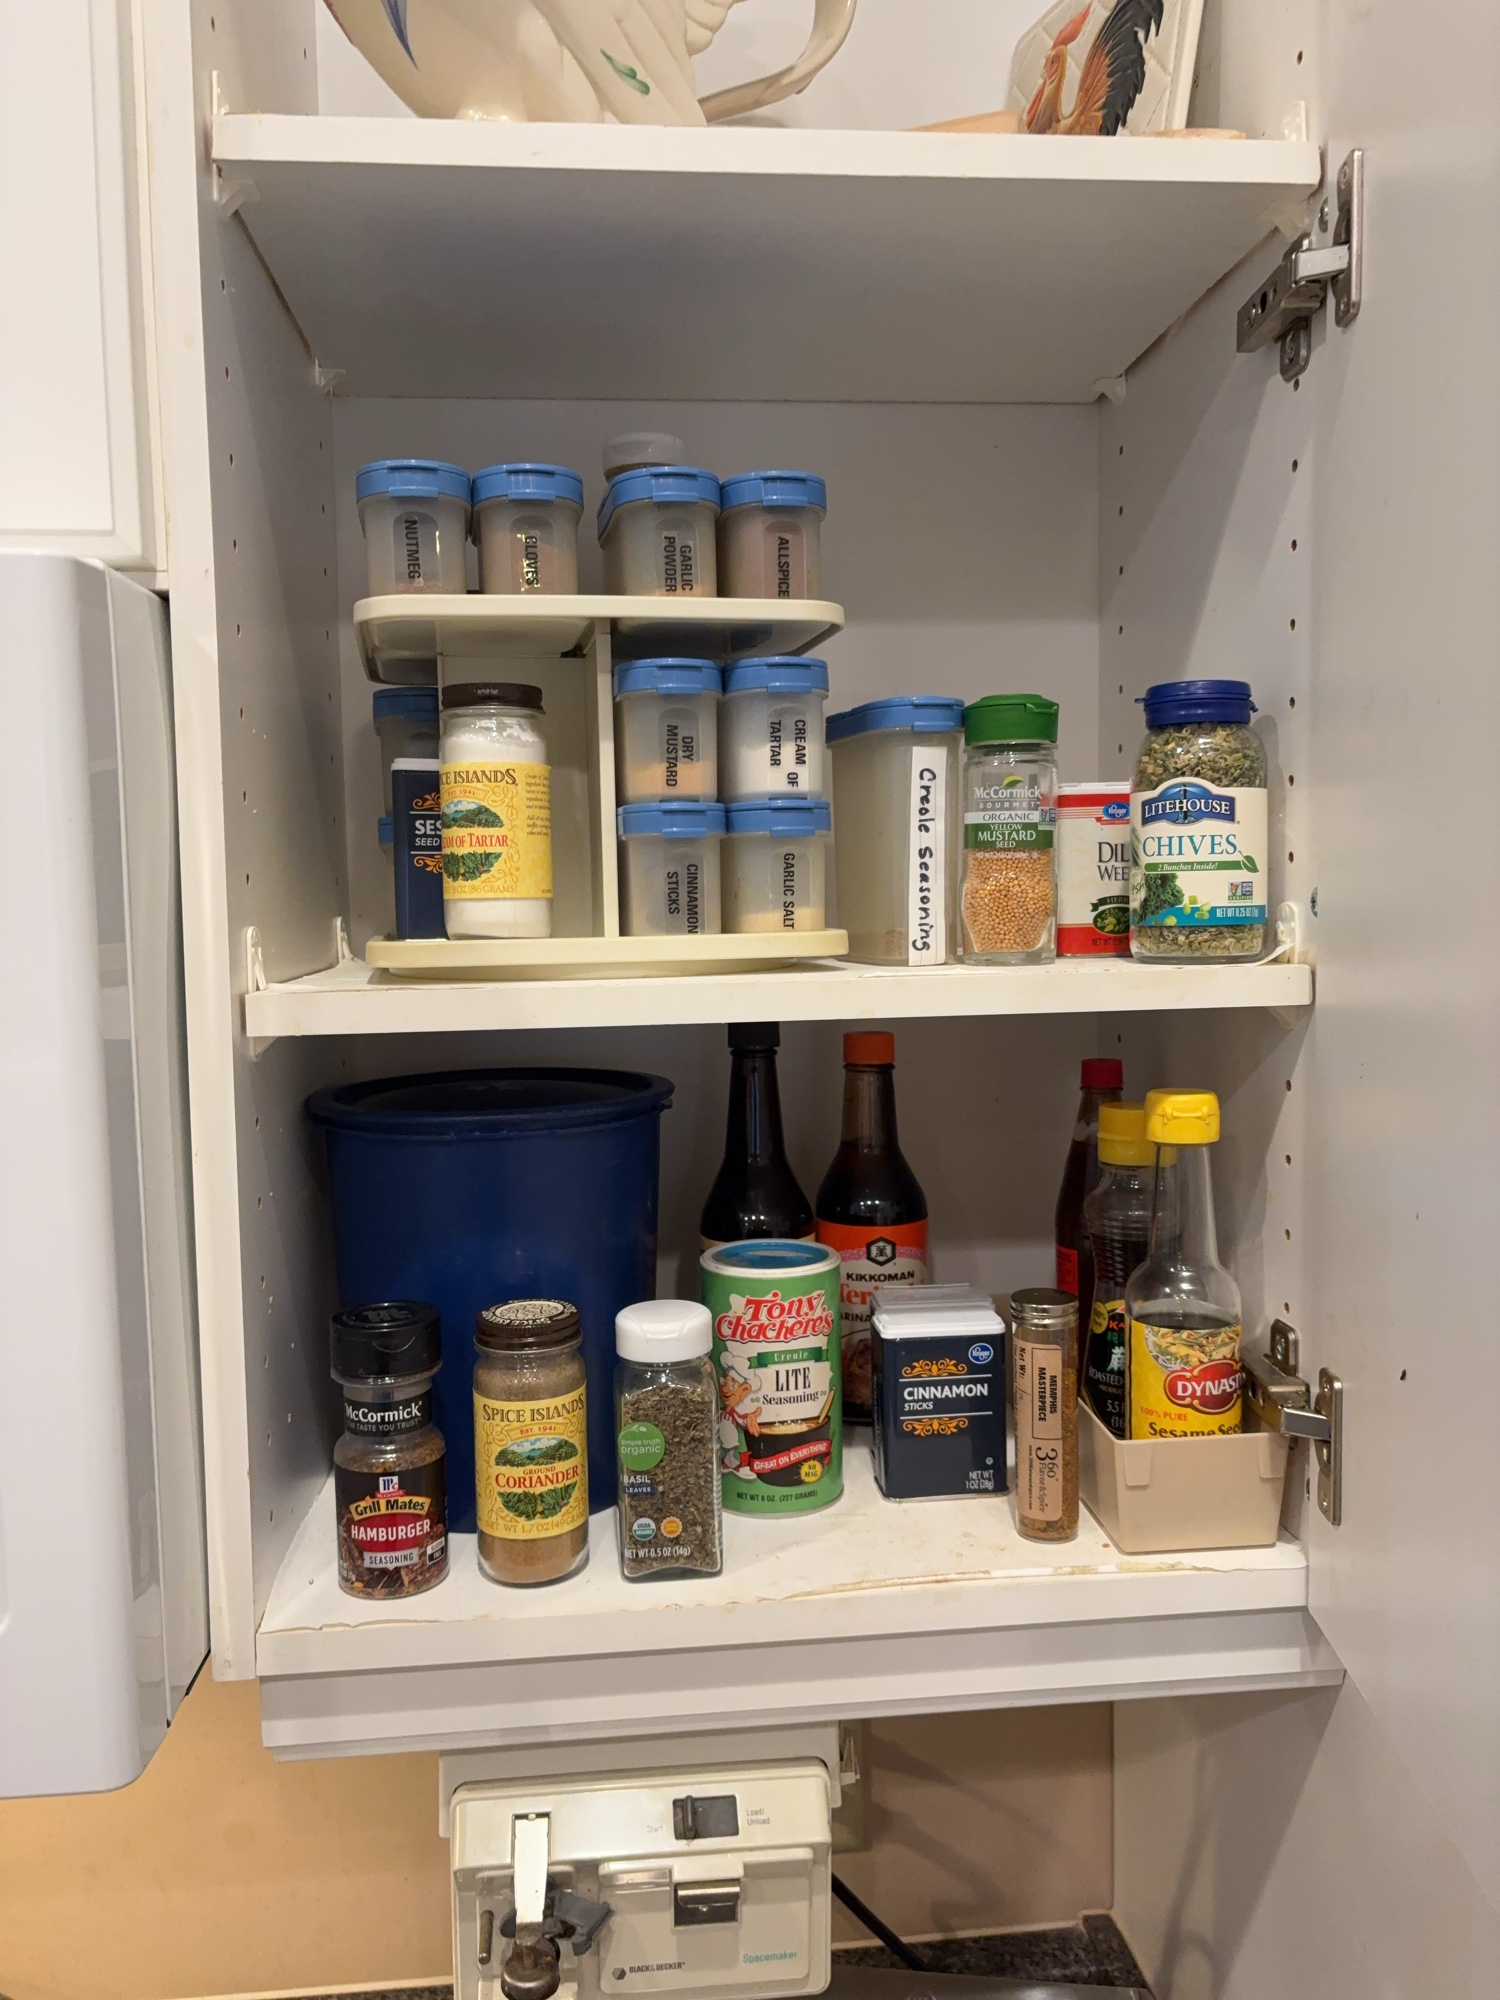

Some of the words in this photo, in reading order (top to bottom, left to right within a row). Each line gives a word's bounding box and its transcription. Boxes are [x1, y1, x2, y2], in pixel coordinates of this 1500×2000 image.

[404, 518, 422, 580] NUTMEG
[524, 536, 539, 587] CLOVES
[663, 535, 677, 592] POWDER
[679, 545, 694, 591] GARLIC
[777, 535, 790, 597] ALLSPICE
[682, 735, 694, 762] DRY
[769, 719, 782, 767] TARTAR
[794, 719, 807, 765] CREAM
[665, 724, 679, 787] MUSTARD
[453, 768, 517, 785] ISLANDS
[787, 772, 799, 788] OF
[973, 785, 1043, 800] McCormick
[917, 768, 937, 834] Creole
[979, 801, 1035, 809] GOURMET
[1144, 798, 1231, 818] LITEHOUSE
[982, 812, 1035, 822] ORGANIC
[1108, 804, 1127, 818] Kroger
[415, 819, 442, 835] SES
[989, 823, 1023, 831] YELLOW
[415, 837, 440, 847] SEED
[455, 835, 466, 848] OF
[468, 832, 509, 848] TARTAR
[977, 830, 1036, 842] MUSTARD
[995, 840, 1016, 848] SEED
[1142, 833, 1238, 857] CHIVES
[1097, 841, 1130, 864] DIL
[1097, 865, 1130, 882] WEE
[1163, 863, 1192, 871] Bunches
[1193, 862, 1218, 870] Inside!
[783, 852, 795, 897] GARLIC
[667, 871, 680, 915] STICKS
[686, 863, 699, 934] CINNAMON
[911, 846, 934, 952] Seasoning
[783, 900, 795, 929] SALT
[1216, 907, 1226, 918] NET
[1227, 907, 1235, 917] WT
[846, 1270, 915, 1283] KIKKOMAN
[743, 1289, 825, 1321] Tony
[716, 1306, 835, 1342] Chachere's
[774, 1350, 809, 1362] Creole
[971, 1346, 991, 1361] Kroger
[775, 1366, 811, 1392] LITE
[762, 1390, 820, 1405] Seasoning
[903, 1383, 989, 1400] CINNAMON
[1038, 1366, 1047, 1422] MASTERPIECE
[1049, 1374, 1058, 1415] MEMPHIS
[345, 1402, 422, 1423] McCormick
[482, 1403, 526, 1423] SPICE
[530, 1393, 585, 1422] ISLANDS
[903, 1402, 934, 1411] STICKS
[1140, 1406, 1161, 1418] 100%
[1163, 1411, 1188, 1421] PURE
[357, 1423, 377, 1432] TASTE
[379, 1423, 395, 1431] YOU
[397, 1419, 418, 1429] TRUST
[538, 1425, 556, 1433] 1941
[1218, 1423, 1241, 1436] See
[621, 1439, 642, 1448] simple
[643, 1437, 661, 1446] truth
[621, 1444, 661, 1456] organic
[522, 1465, 556, 1476] GROUND
[753, 1459, 777, 1470] GREAT
[778, 1456, 789, 1464] ON
[494, 1464, 580, 1489] CORIANDER
[623, 1474, 651, 1484] BASIL
[969, 1471, 981, 1480] NET
[982, 1470, 994, 1479] WT
[970, 1480, 979, 1490] OZ
[736, 1491, 748, 1500] NET
[749, 1493, 759, 1501] WT
[354, 1501, 381, 1517] Grill
[385, 1498, 426, 1511] Mates
[351, 1519, 431, 1542] HAMBURGER
[485, 1519, 501, 1531] NET
[504, 1523, 518, 1533] WT
[522, 1523, 535, 1534] 1.7
[536, 1521, 550, 1533] OZ
[369, 1552, 414, 1565] SEASONING
[624, 1548, 636, 1559] NET
[638, 1548, 649, 1558] WT
[663, 1546, 672, 1556] OZ
[746, 1807, 765, 1816] Load/
[646, 1824, 664, 1833] Start
[747, 1817, 771, 1826] Unload
[742, 1951, 798, 1965] Spacemaker
